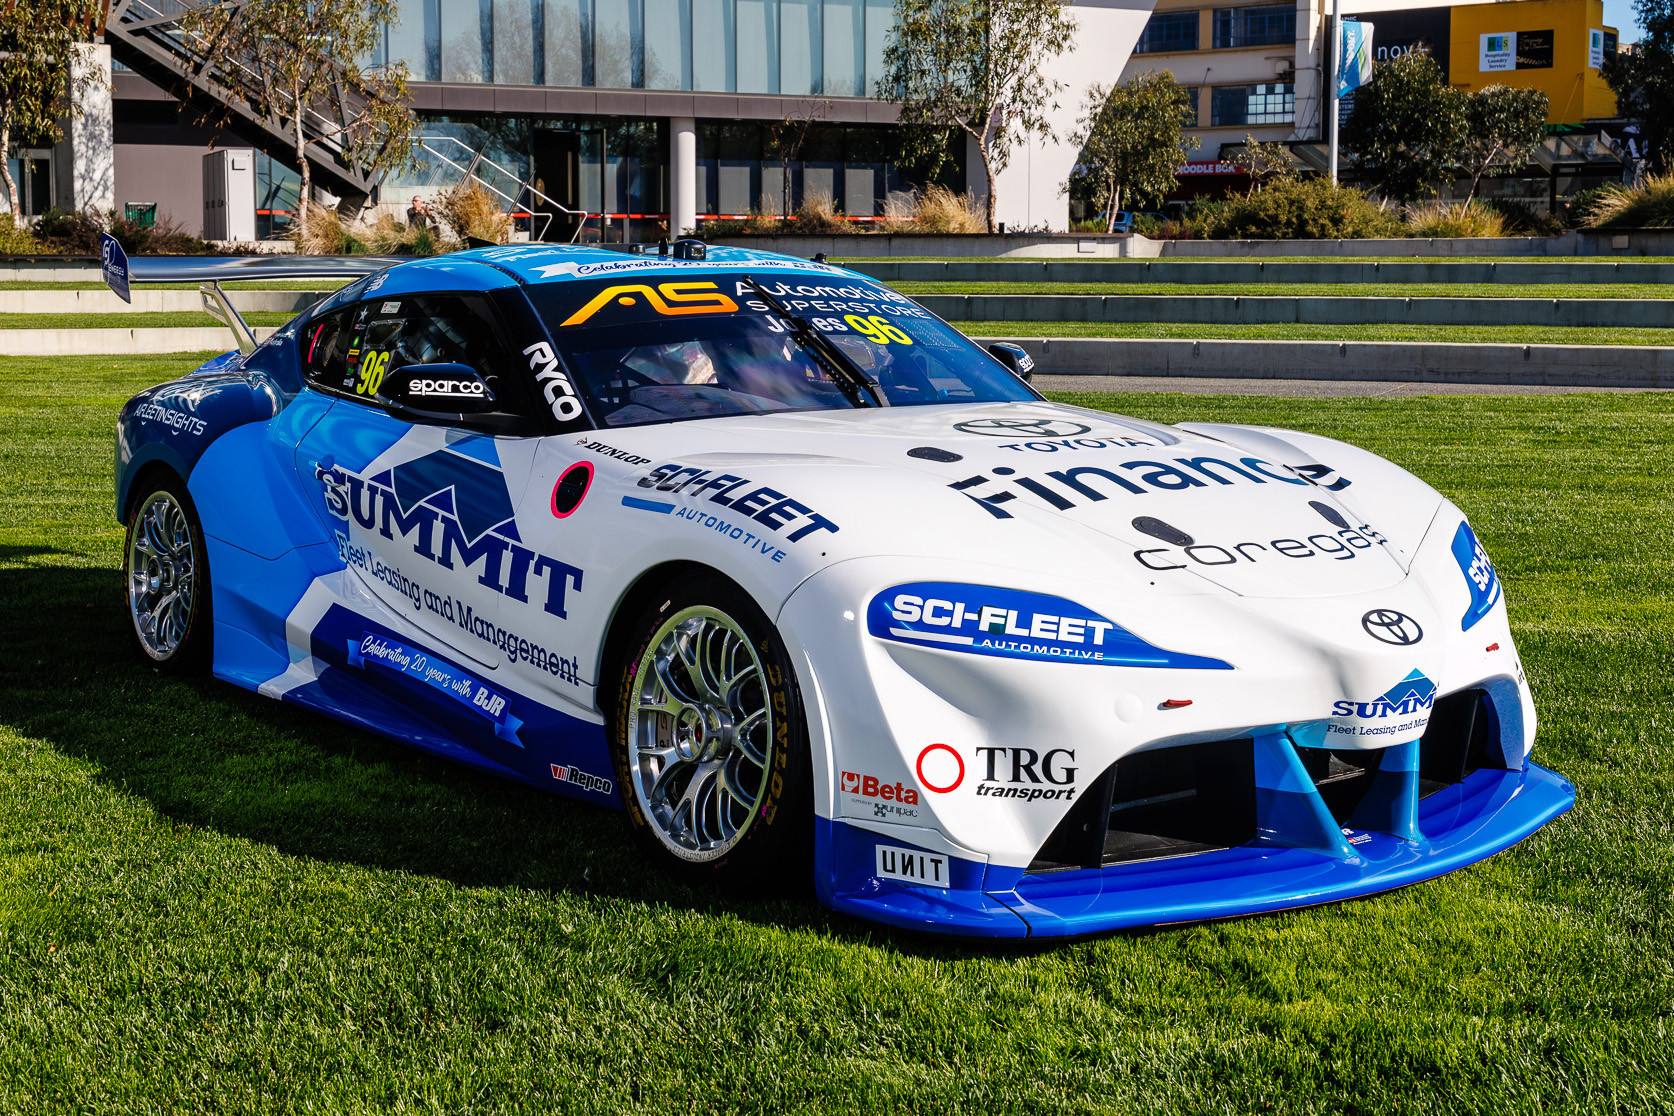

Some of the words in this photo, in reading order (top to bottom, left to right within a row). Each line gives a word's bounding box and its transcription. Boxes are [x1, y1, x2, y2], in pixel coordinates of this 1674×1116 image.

[1488, 40, 1508, 48] HLS
[735, 281, 906, 304] Automotive
[843, 314, 914, 345] 96
[356, 350, 390, 396] 96
[408, 378, 485, 397] sparco
[523, 341, 583, 422] RYCO
[584, 441, 652, 466] DUNLOP
[997, 436, 1157, 453] TOYOTA
[636, 464, 840, 543] SCI-FLEET
[946, 456, 1352, 519] Finance
[318, 463, 584, 621] SUMMIT
[675, 506, 787, 563] AUTOMOTIVE
[1134, 524, 1388, 570] coregas
[334, 529, 369, 568] Fleet
[368, 550, 421, 610] Leasing
[423, 589, 456, 624] and
[456, 600, 580, 687] Management
[891, 594, 1114, 645] SCI-FLEET
[980, 639, 1104, 661] AUTOMOTIVE
[410, 653, 427, 672] 20
[425, 666, 451, 688] years
[451, 679, 472, 698] with
[473, 686, 506, 717] BJR
[766, 663, 788, 827] DUNLOP
[1326, 724, 1356, 736] Fleet
[1359, 723, 1396, 736] Leasing
[1397, 721, 1414, 731] and
[568, 765, 612, 794] Repco
[975, 746, 1079, 786] TRG
[862, 774, 919, 806] Beta
[975, 782, 1077, 803] transport
[881, 849, 943, 882] UNIT
